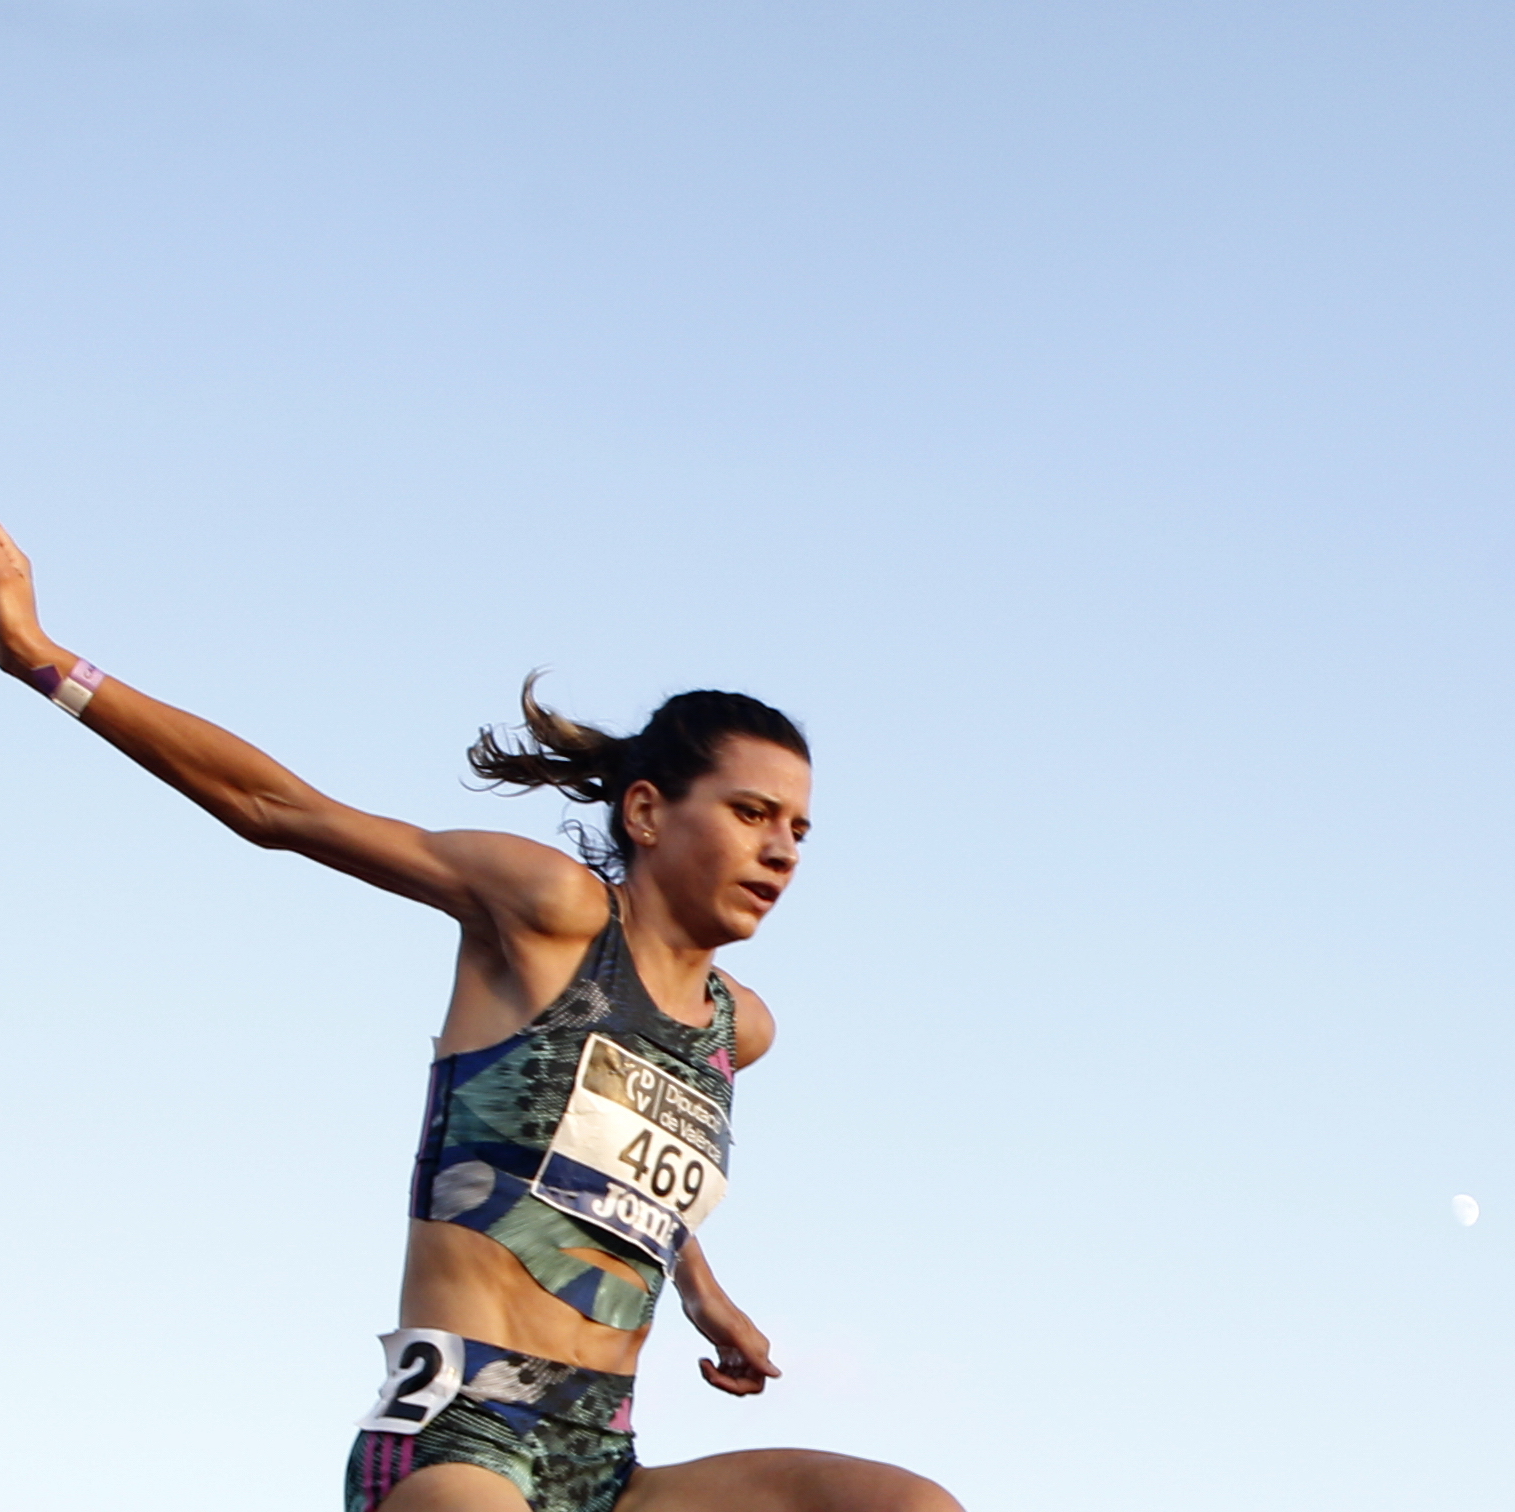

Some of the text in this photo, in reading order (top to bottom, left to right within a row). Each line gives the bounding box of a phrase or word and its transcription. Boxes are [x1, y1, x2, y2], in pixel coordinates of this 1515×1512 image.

[659, 1110, 678, 1132] de
[618, 1128, 704, 1212] 469
[386, 1341, 443, 1422] 2
